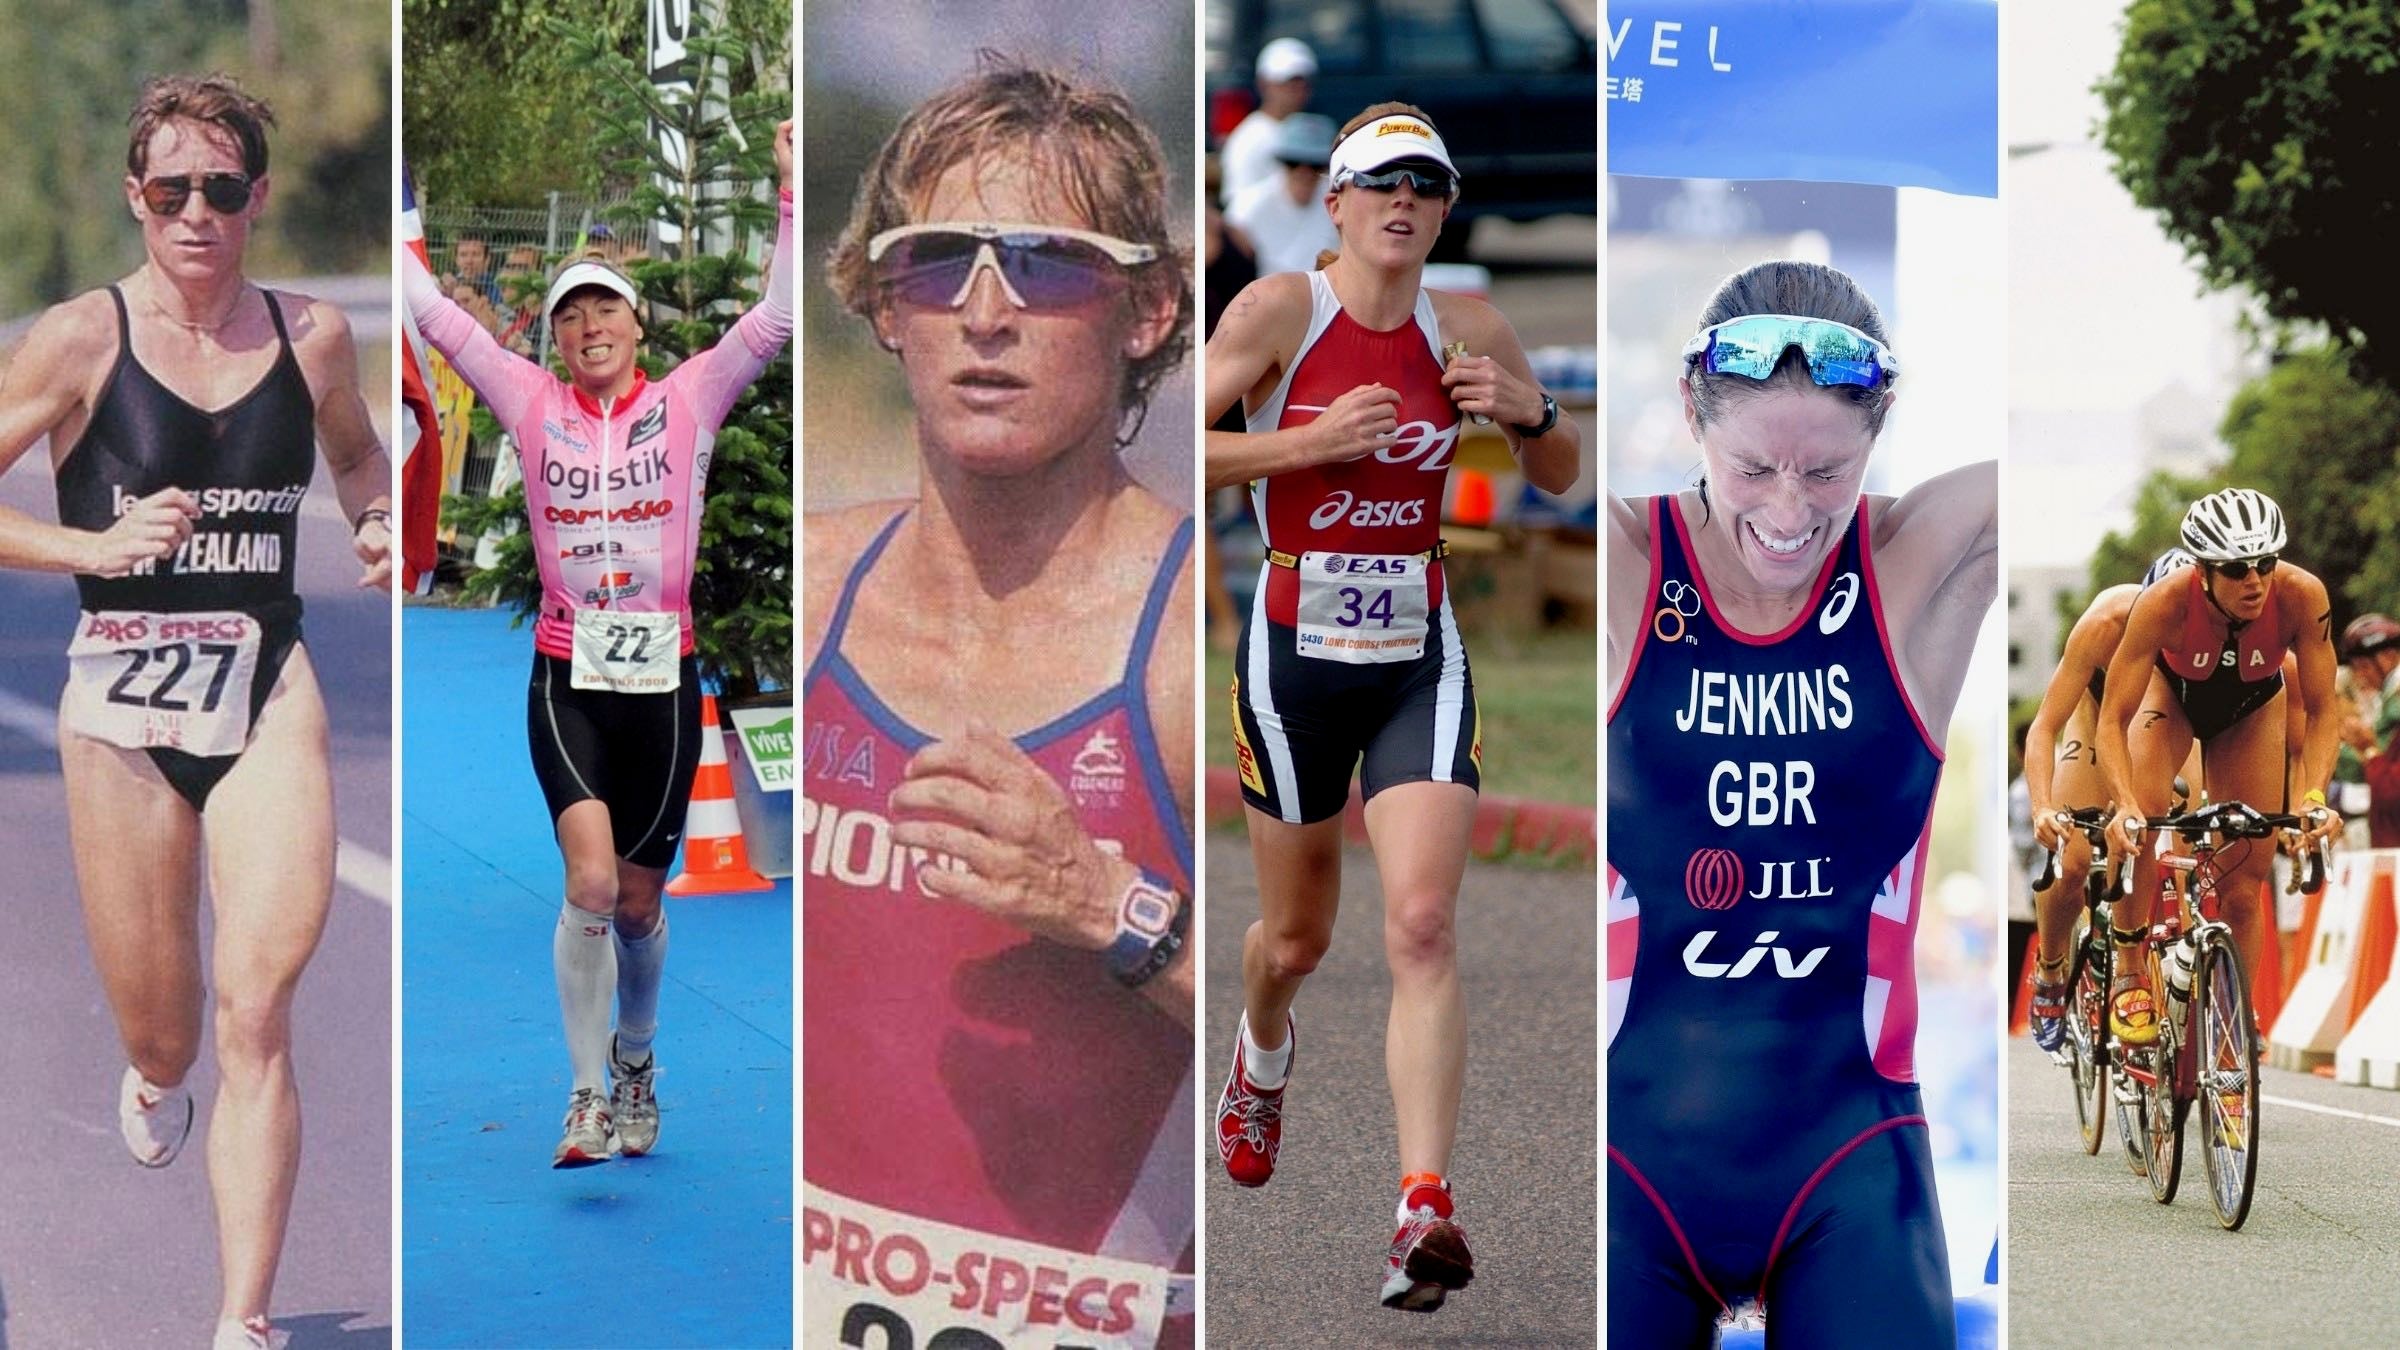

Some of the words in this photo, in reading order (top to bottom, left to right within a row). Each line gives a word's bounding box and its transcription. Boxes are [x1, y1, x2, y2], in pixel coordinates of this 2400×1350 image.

[1607, 17, 1732, 73] VEL
[1378, 123, 1430, 137] PowerBar
[540, 447, 673, 499] logistik
[173, 532, 281, 574] ZEALAND
[1346, 557, 1407, 575] EAS
[86, 617, 150, 642] PRO
[159, 618, 248, 640] SPECS
[1335, 586, 1395, 629] 34
[605, 624, 651, 663] 22
[1301, 633, 1323, 645] 5430
[1324, 637, 1347, 648] LONG
[1348, 639, 1380, 650] COURSE
[1381, 637, 1421, 650] TRIATHLON
[106, 643, 238, 712] 227
[1675, 663, 1854, 736] JENKINS
[1707, 760, 1817, 828] GBR
[1748, 856, 1834, 900] JLL
[1682, 930, 1832, 979] Liv
[803, 1205, 1141, 1335] PRO-SPECS
